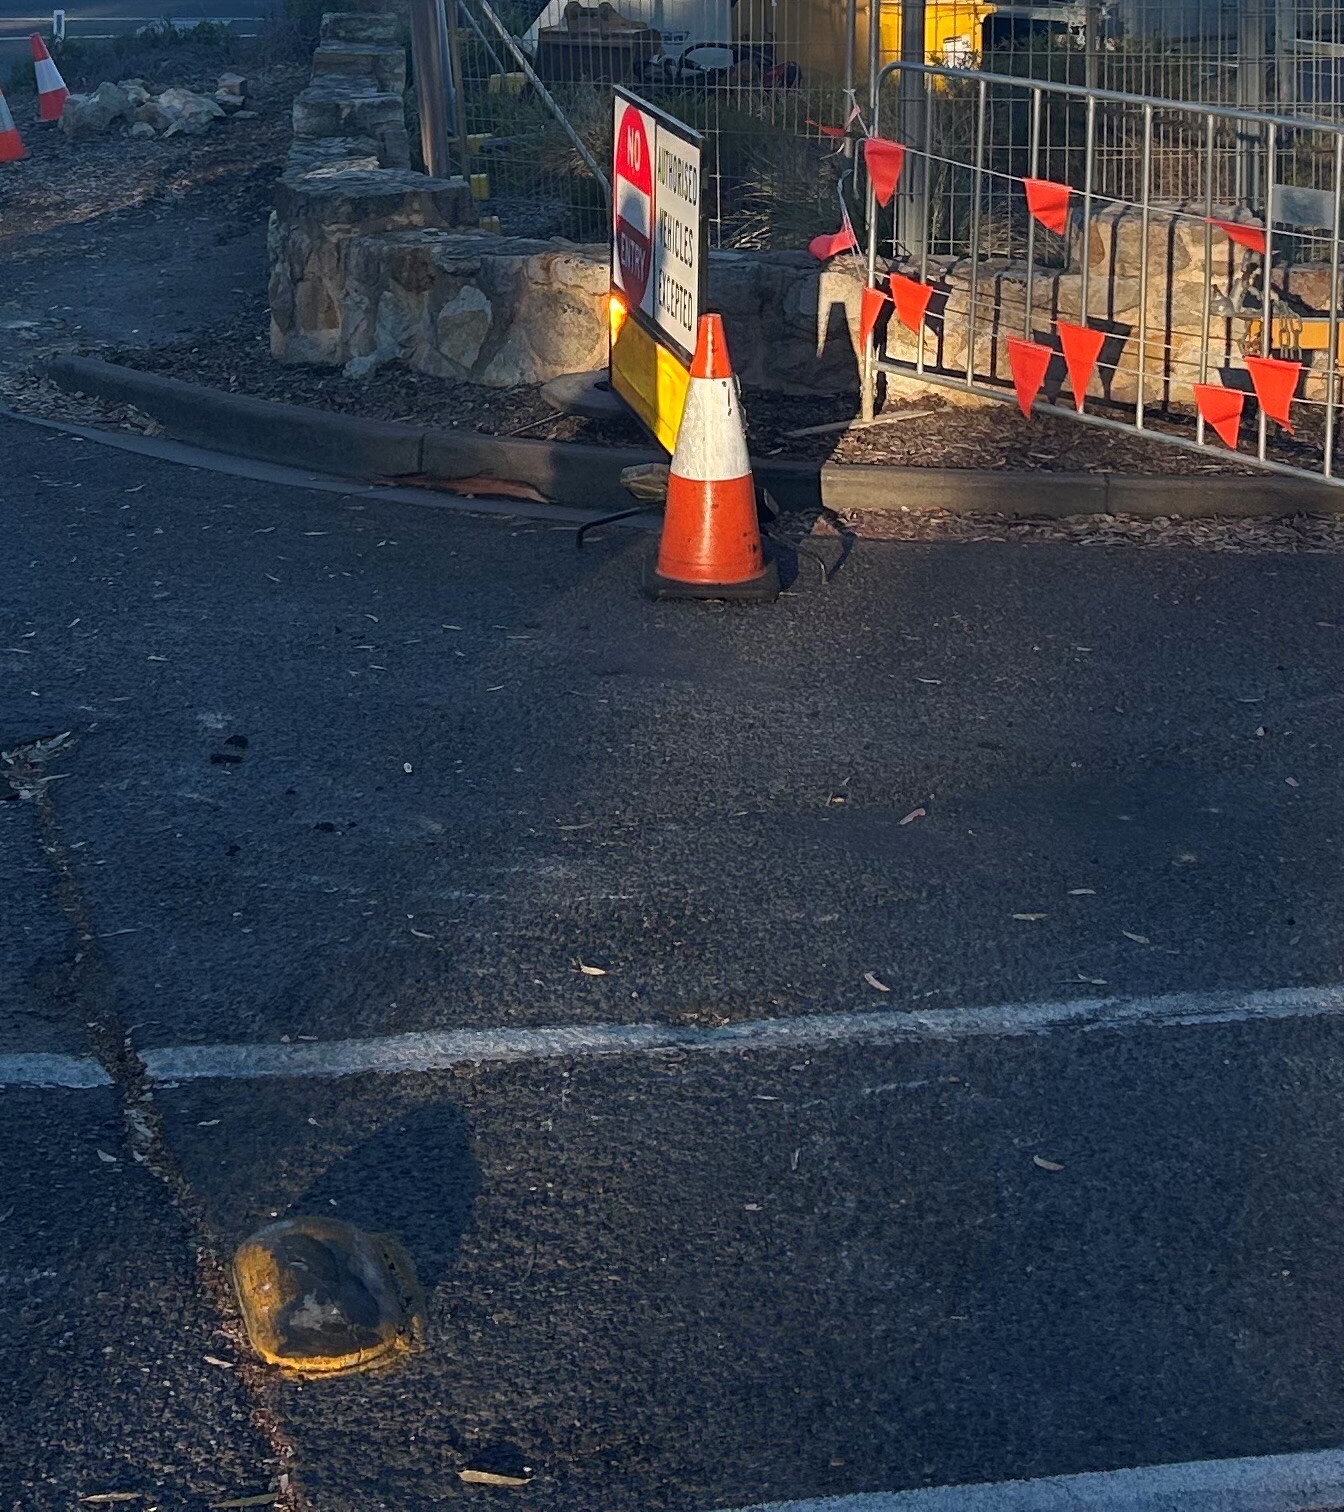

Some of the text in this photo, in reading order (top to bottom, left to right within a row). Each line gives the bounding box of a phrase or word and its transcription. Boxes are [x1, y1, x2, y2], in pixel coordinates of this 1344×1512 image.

[626, 124, 641, 172] NO
[658, 145, 698, 207] AUTHORISED
[620, 231, 647, 284] ENTRY
[659, 208, 693, 269] VEHICLES
[658, 269, 693, 332] EXCEPTED
